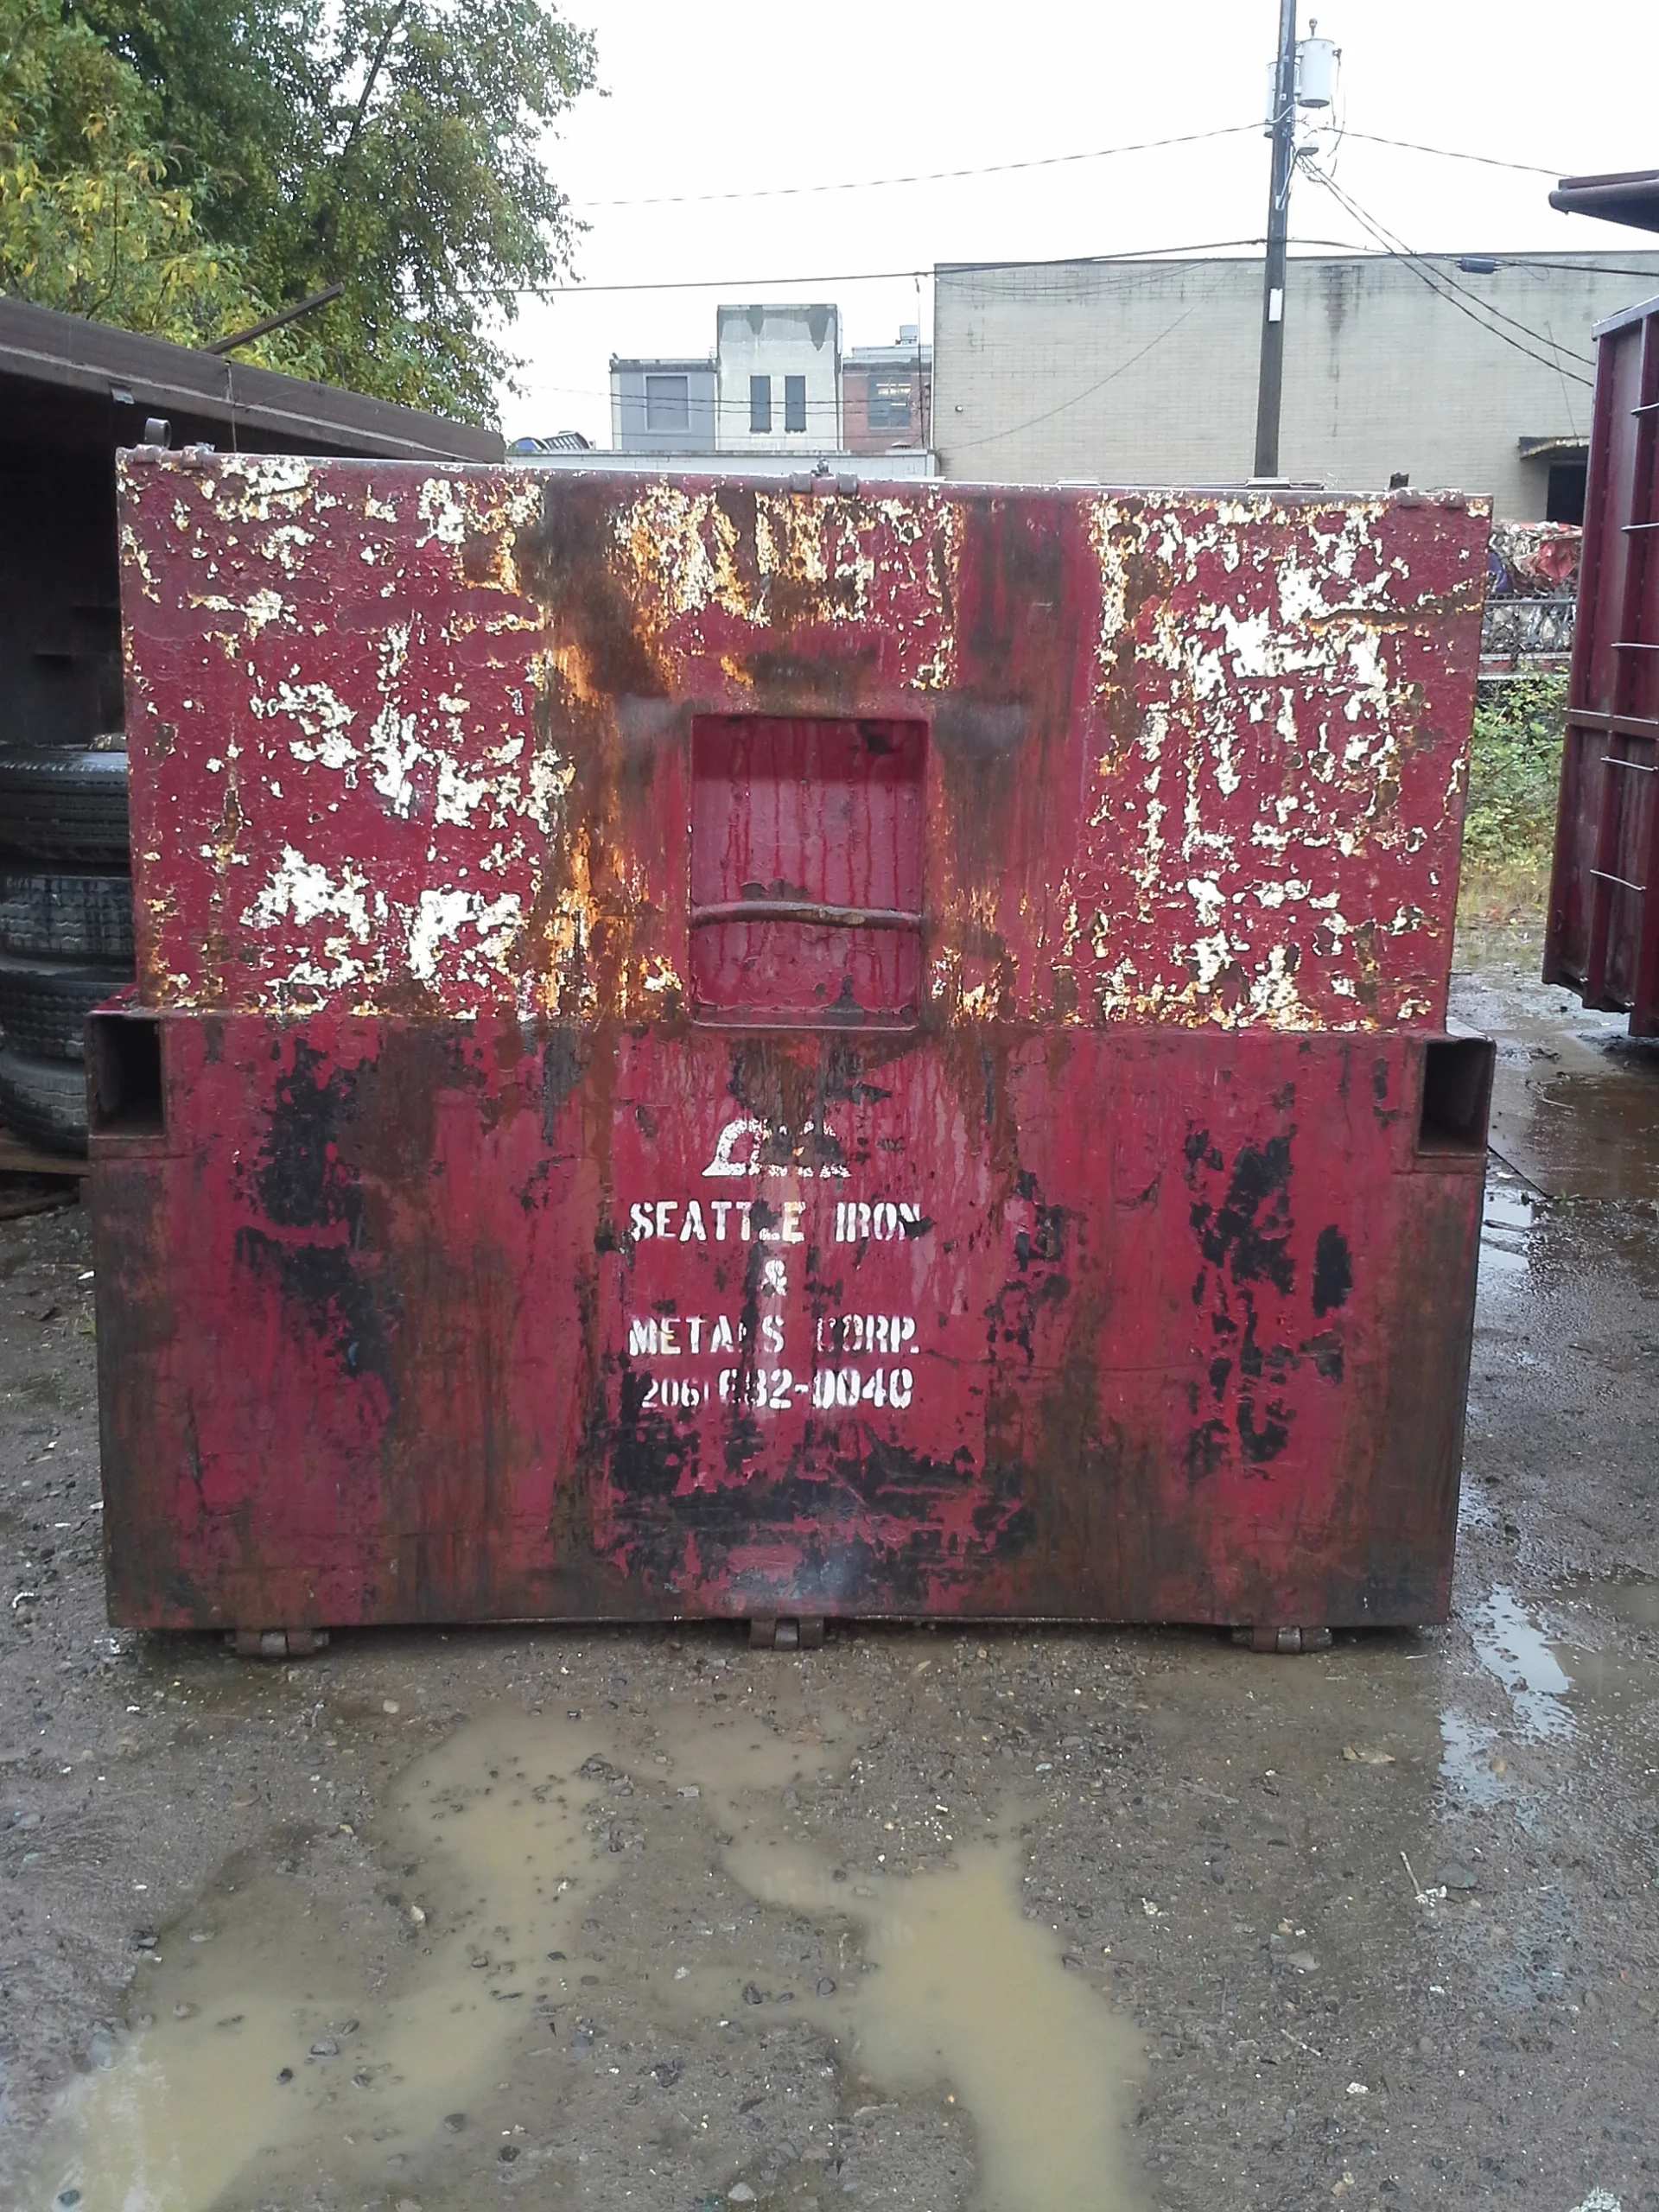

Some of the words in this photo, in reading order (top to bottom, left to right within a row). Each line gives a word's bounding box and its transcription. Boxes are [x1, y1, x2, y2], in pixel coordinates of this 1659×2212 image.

[835, 1202, 922, 1243] IRON
[761, 1260, 787, 1296] &
[629, 1314, 785, 1356] METAS
